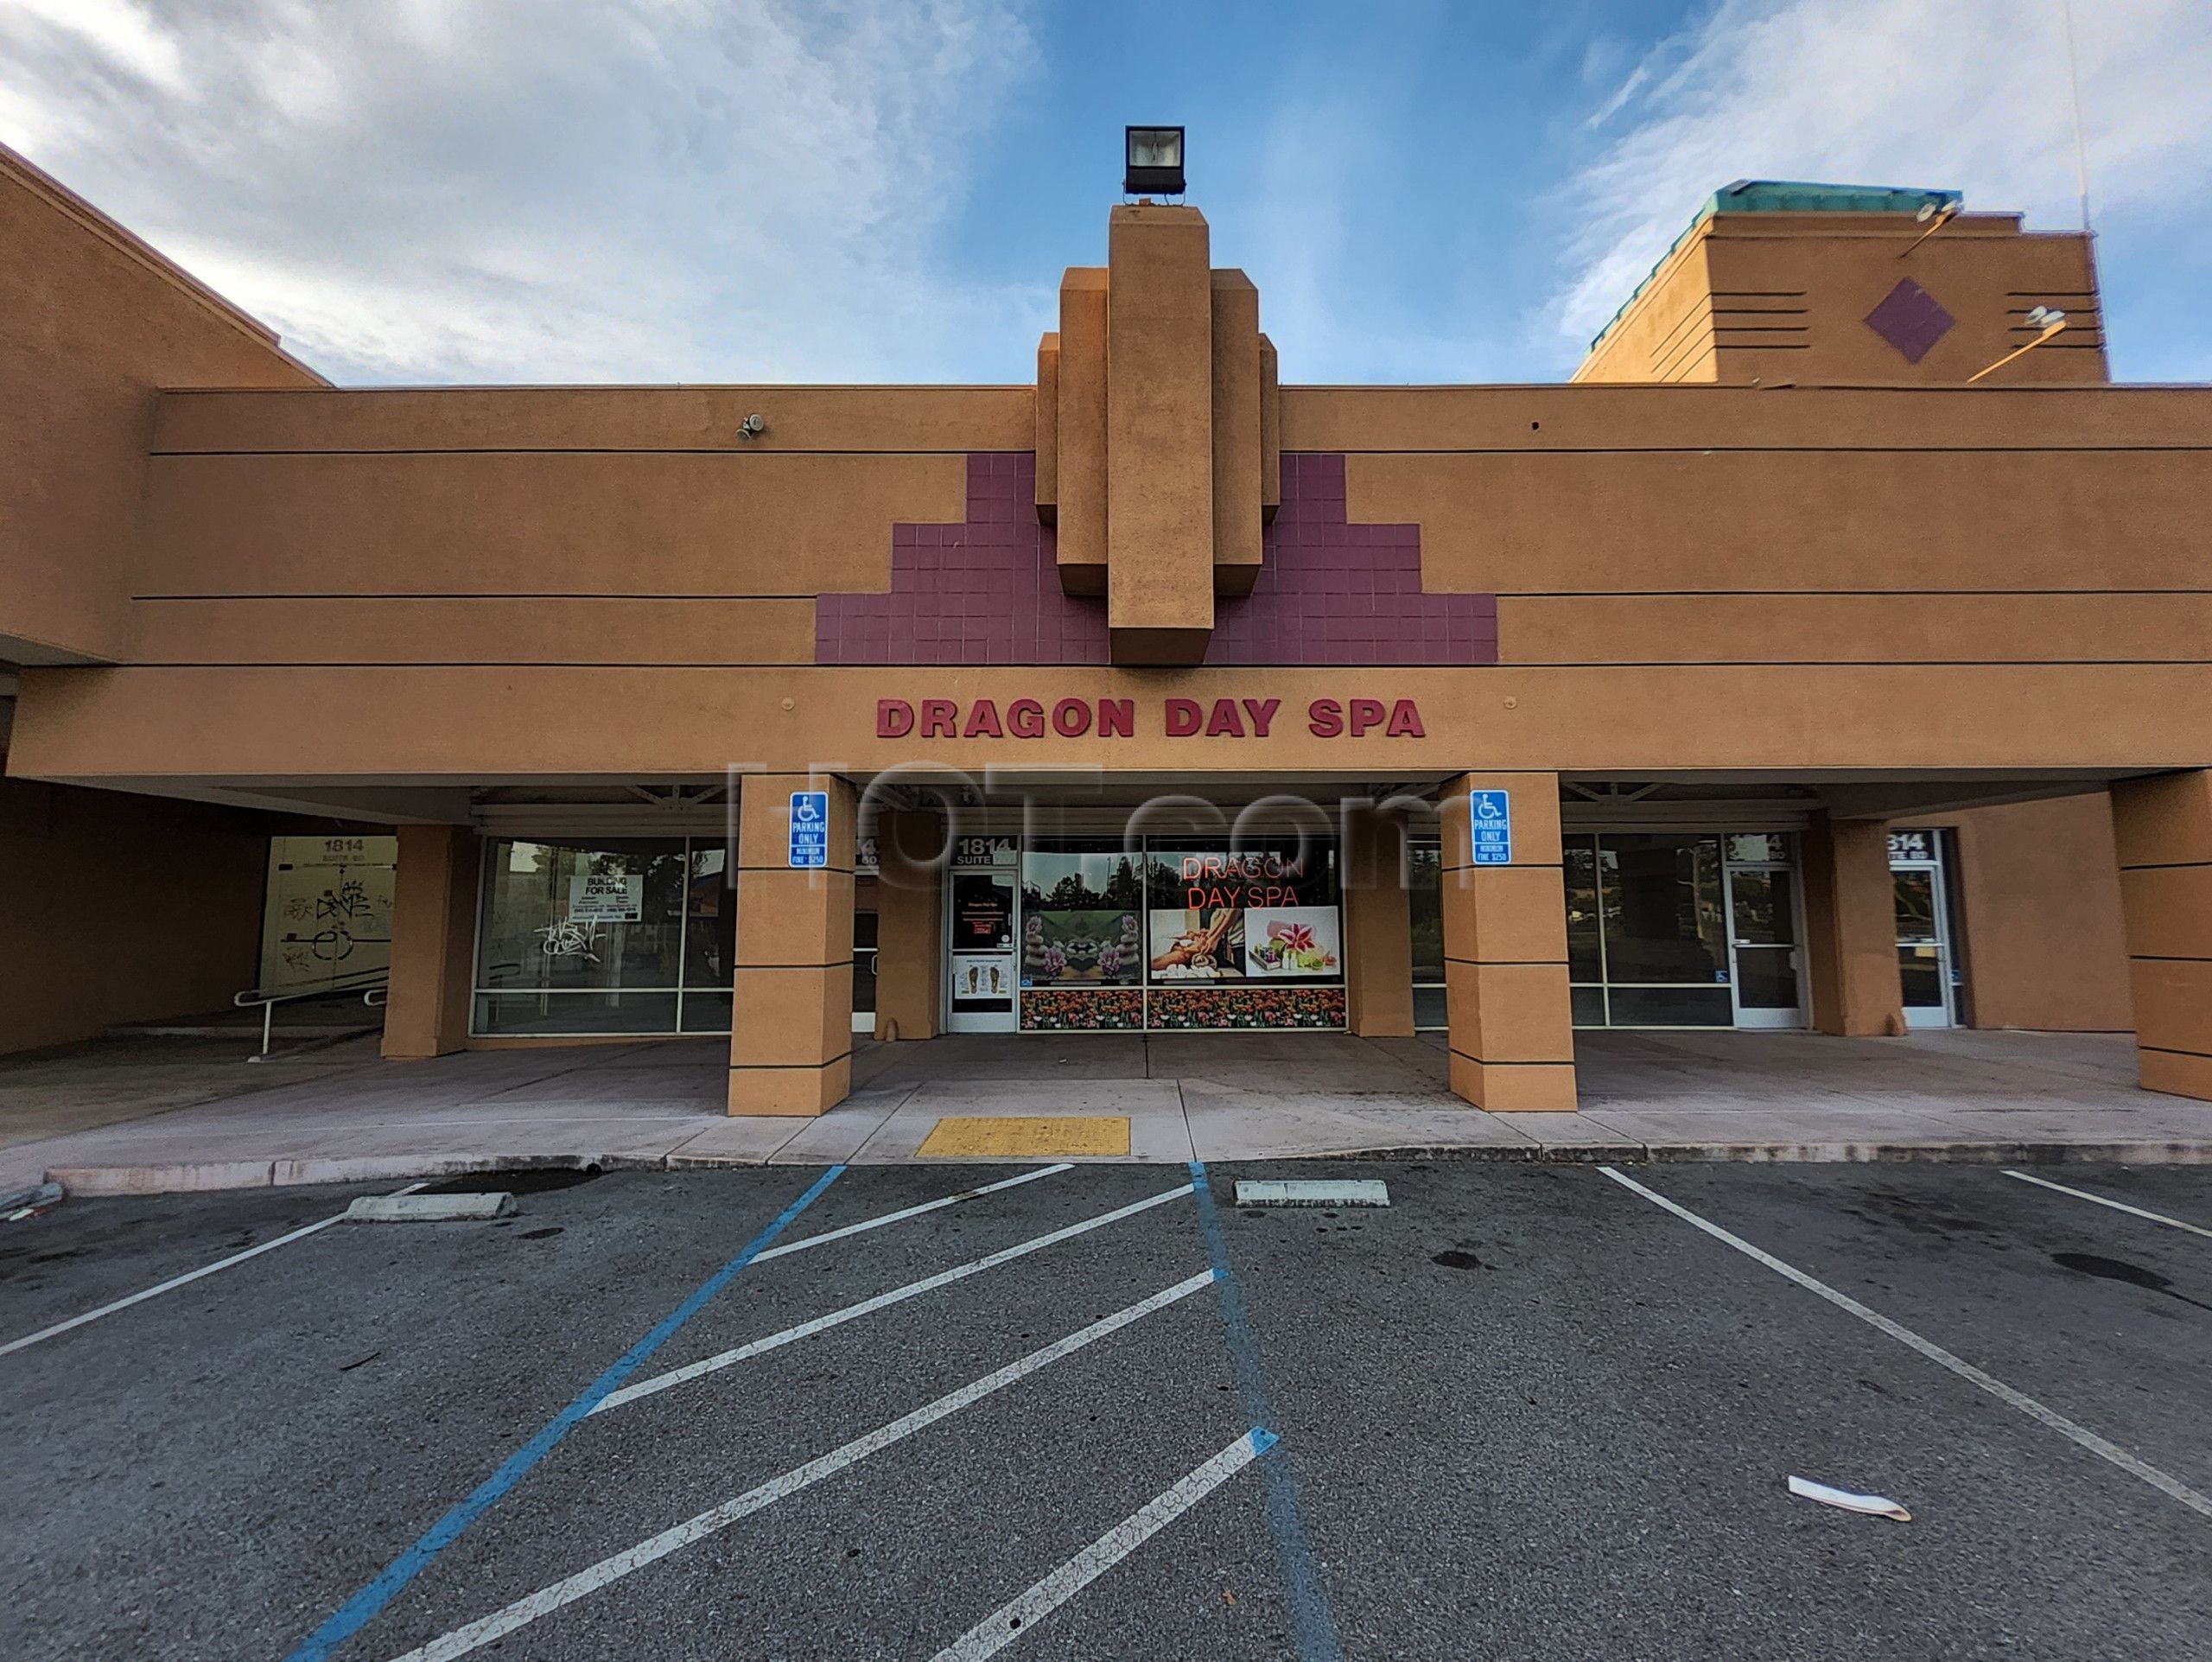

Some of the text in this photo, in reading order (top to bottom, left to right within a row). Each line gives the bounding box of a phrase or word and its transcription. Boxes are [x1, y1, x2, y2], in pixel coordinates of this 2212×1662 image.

[876, 697, 1426, 739] DRAGON DAY SPA
[792, 822, 825, 833] PARKING
[1474, 819, 1508, 831] PARKING
[798, 833, 819, 844] ONLY
[1480, 831, 1502, 842] ONLY
[325, 838, 364, 852] 1814
[958, 837, 1011, 855] 1814
[957, 856, 991, 865] SUITE
[1183, 856, 1304, 881] DRAGON
[585, 886, 627, 895] FOR SALE
[1188, 886, 1300, 910] DAY SPA
